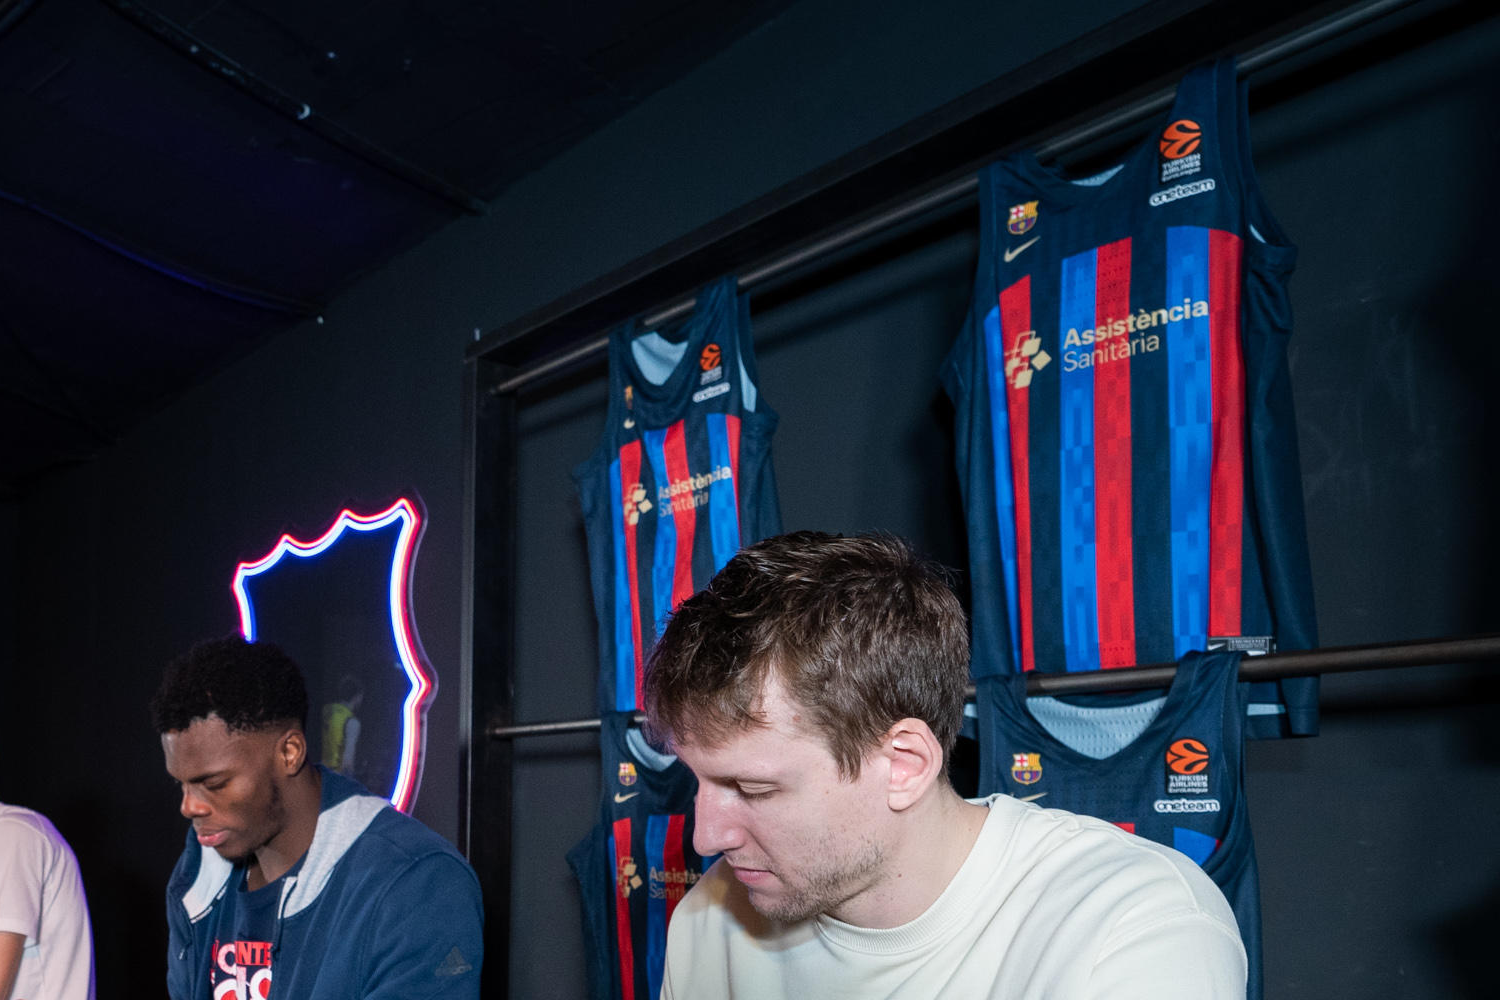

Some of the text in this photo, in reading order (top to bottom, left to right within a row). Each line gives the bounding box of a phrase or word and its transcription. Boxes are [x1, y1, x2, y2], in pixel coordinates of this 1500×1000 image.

[1149, 179, 1215, 206] oneteam
[1063, 298, 1209, 350] Assistència
[1063, 332, 1160, 372] Sanitària
[1154, 798, 1220, 813] oneteam
